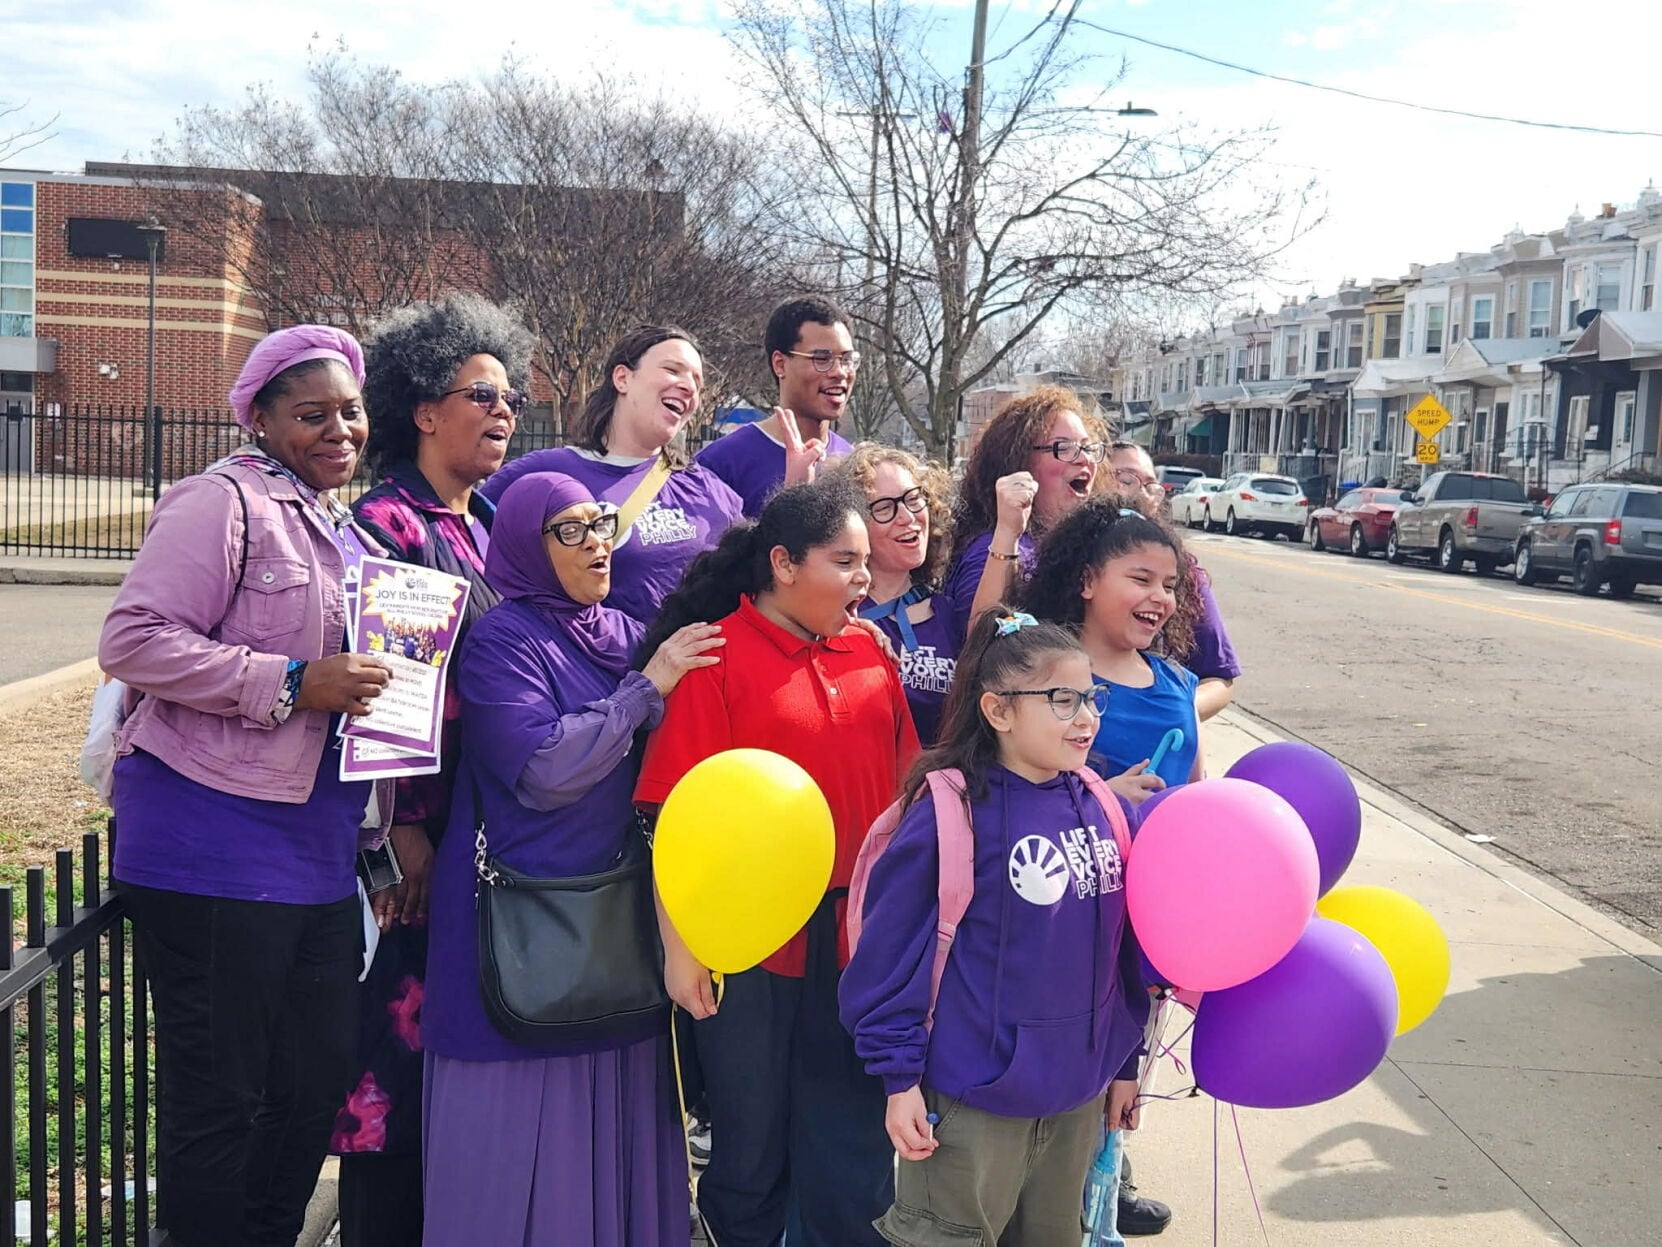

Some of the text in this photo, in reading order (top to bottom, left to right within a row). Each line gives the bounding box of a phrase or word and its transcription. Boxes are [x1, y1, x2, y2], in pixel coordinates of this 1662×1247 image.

[1417, 409, 1441, 417] SPEED
[1417, 418, 1440, 426] HUMP
[1418, 444, 1437, 455] 20
[640, 507, 685, 522] VERY
[635, 518, 690, 534] VOICE
[639, 525, 697, 546] PHILLY
[376, 590, 396, 600] JOY
[399, 591, 408, 600] IS
[409, 592, 419, 601] IN
[898, 672, 952, 695] PHILL
[1059, 825, 1098, 847] LIFT
[1066, 839, 1120, 864] EVERY
